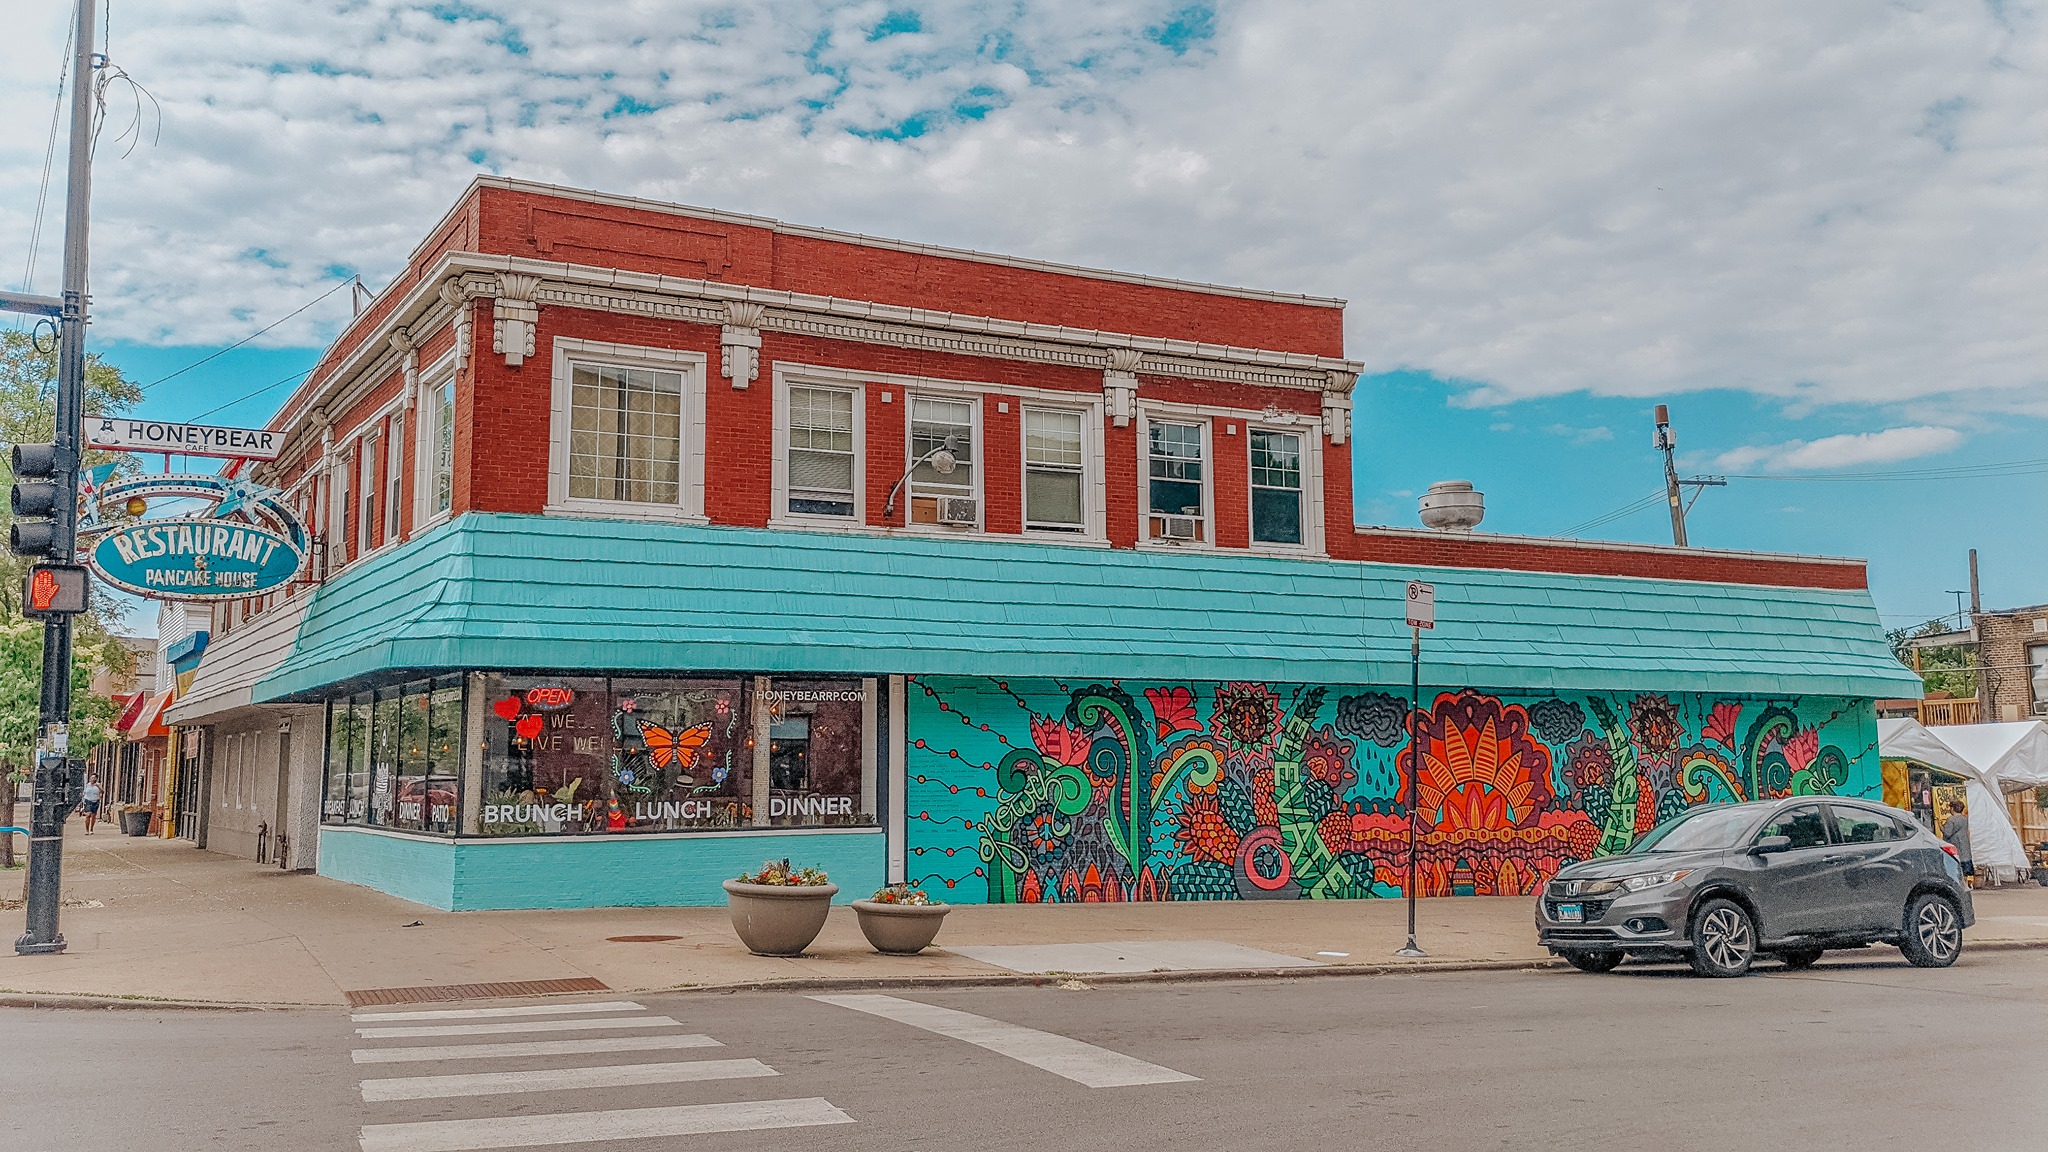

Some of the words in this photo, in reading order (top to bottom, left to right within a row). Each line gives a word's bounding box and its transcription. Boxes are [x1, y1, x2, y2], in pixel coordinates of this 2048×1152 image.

[128, 422, 273, 450] HONEYBEAR
[185, 444, 209, 452] CAFE
[113, 525, 281, 566] RESTAURANT
[146, 569, 211, 587] PANCAKE
[215, 571, 258, 588] HOUSE
[527, 688, 573, 704] OPEN
[756, 690, 867, 702] HONEYBEARRP.COM
[399, 802, 421, 820] DINNER
[431, 804, 449, 822] PATIO
[484, 803, 583, 824] BRUNCH
[635, 800, 712, 820] LUNCH
[770, 797, 852, 817] DINNER
